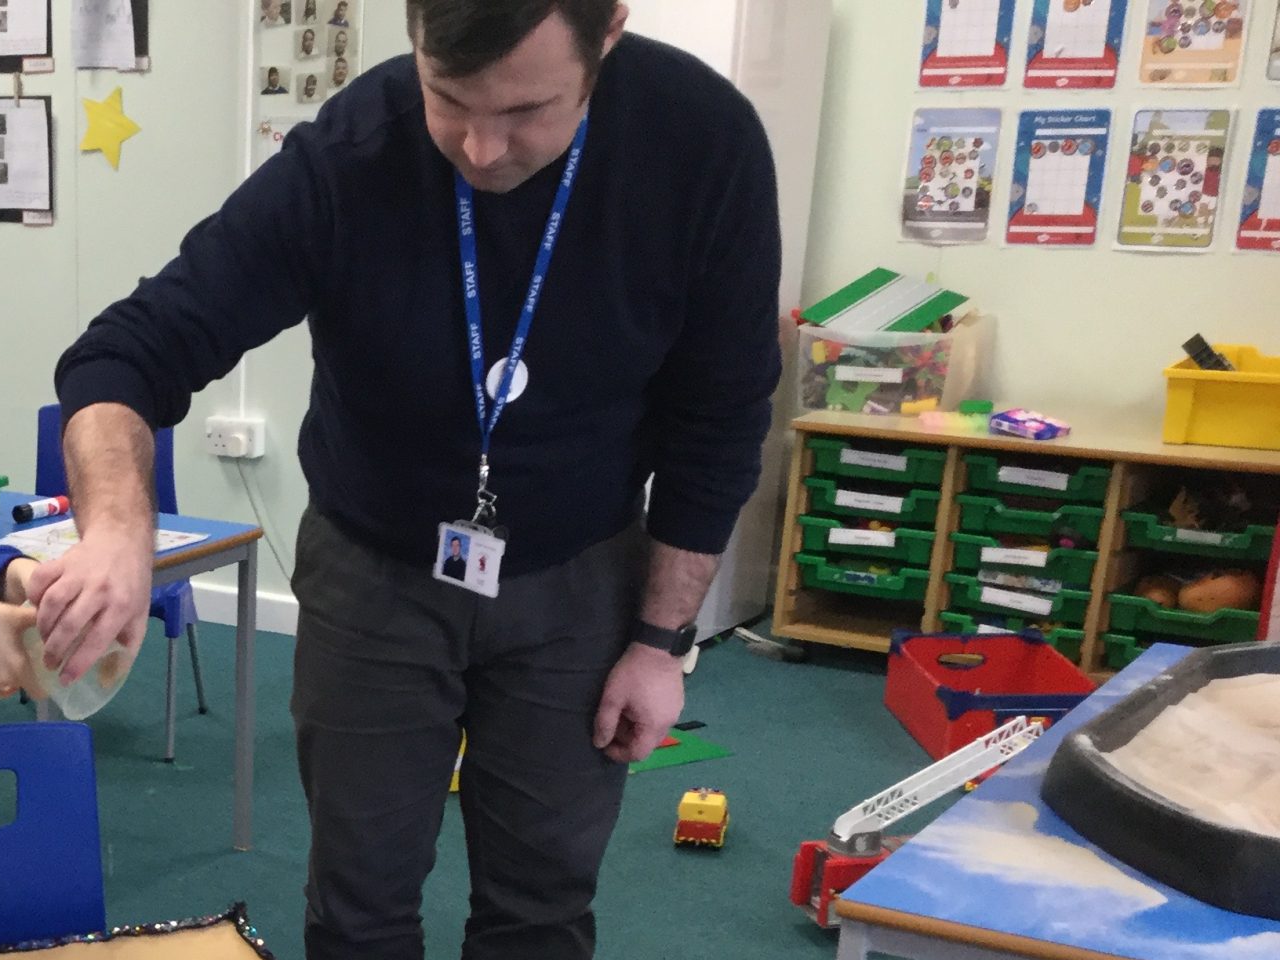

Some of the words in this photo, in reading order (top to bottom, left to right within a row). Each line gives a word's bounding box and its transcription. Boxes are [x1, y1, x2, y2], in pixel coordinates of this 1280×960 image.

[1033, 115, 1047, 125] My
[1047, 115, 1073, 124] Sticker
[1074, 114, 1097, 123] Chart
[561, 148, 581, 187] STAFF
[460, 197, 473, 236] STAFF
[543, 211, 561, 250] STAFF
[464, 261, 477, 298] STAFF
[526, 275, 543, 313] STAFF
[470, 323, 482, 359] STAFF
